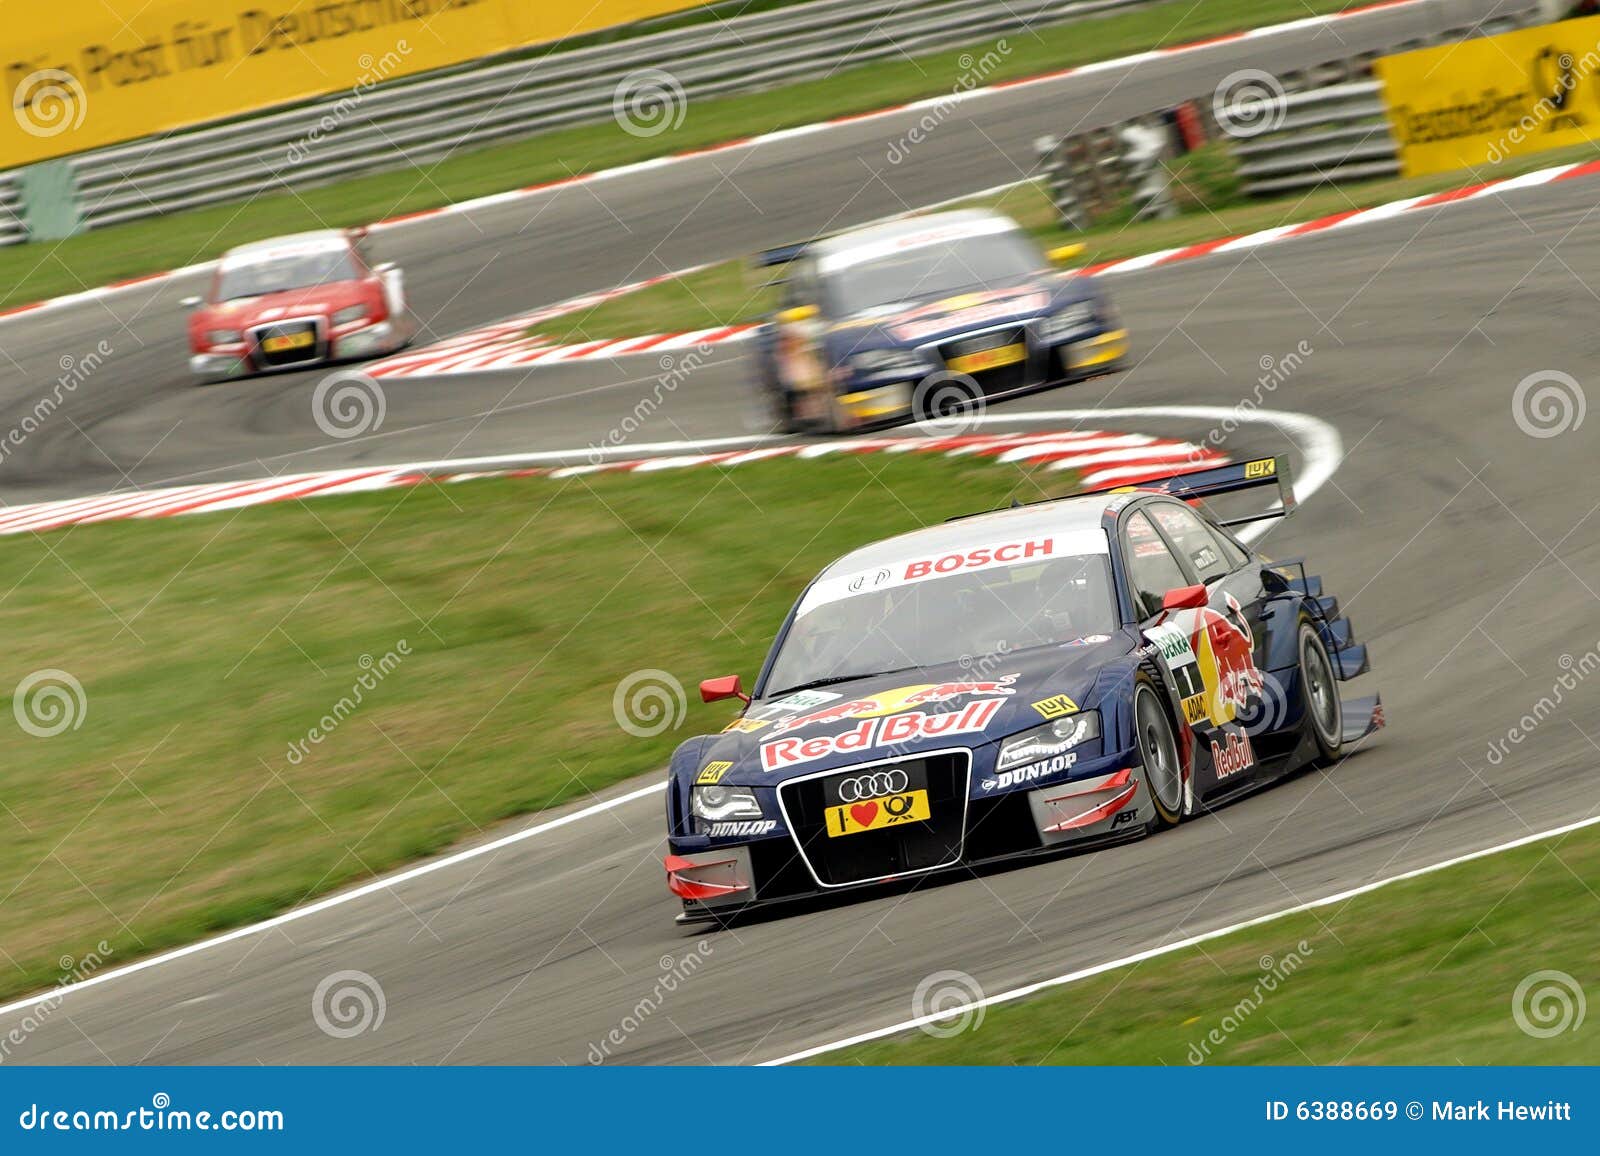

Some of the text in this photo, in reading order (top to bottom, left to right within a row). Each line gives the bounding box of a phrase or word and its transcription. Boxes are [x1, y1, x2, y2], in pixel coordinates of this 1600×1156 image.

[903, 538, 1053, 580] BOSCH
[1181, 666, 1195, 695] 1
[764, 699, 1001, 768] Red Bull
[997, 752, 1077, 789] DUNLOP
[709, 820, 777, 838] DUNLOP
[1110, 808, 1138, 829] ABT
